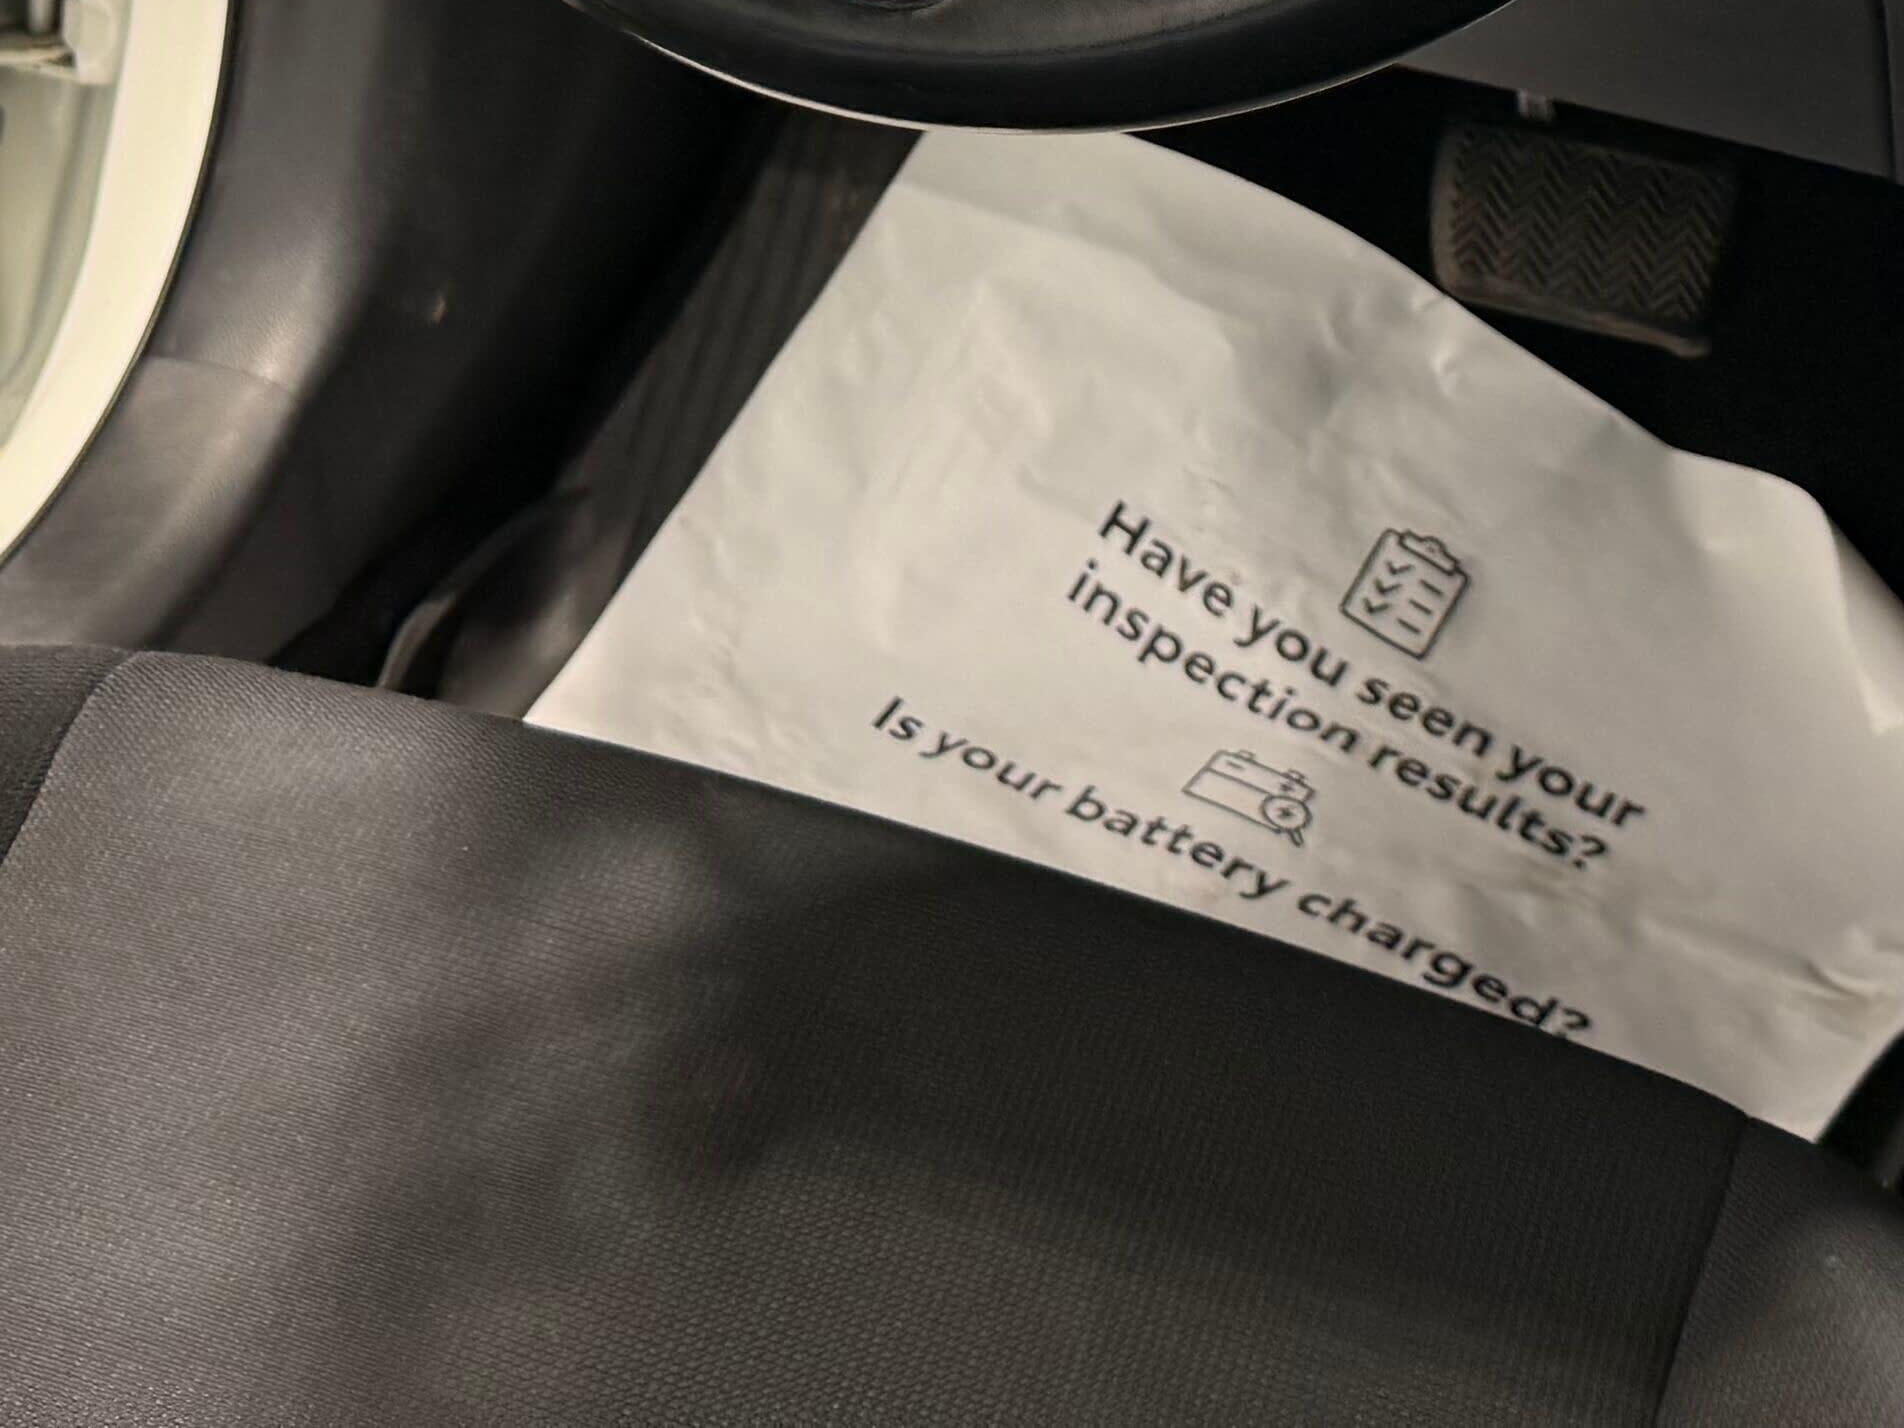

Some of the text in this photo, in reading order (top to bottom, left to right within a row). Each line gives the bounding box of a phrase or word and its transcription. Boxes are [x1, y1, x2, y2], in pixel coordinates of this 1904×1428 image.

[1066, 557, 1610, 871] inspection results?
[1098, 499, 1648, 829] Have you seen your
[870, 694, 1593, 1039] Is your battery charged?
